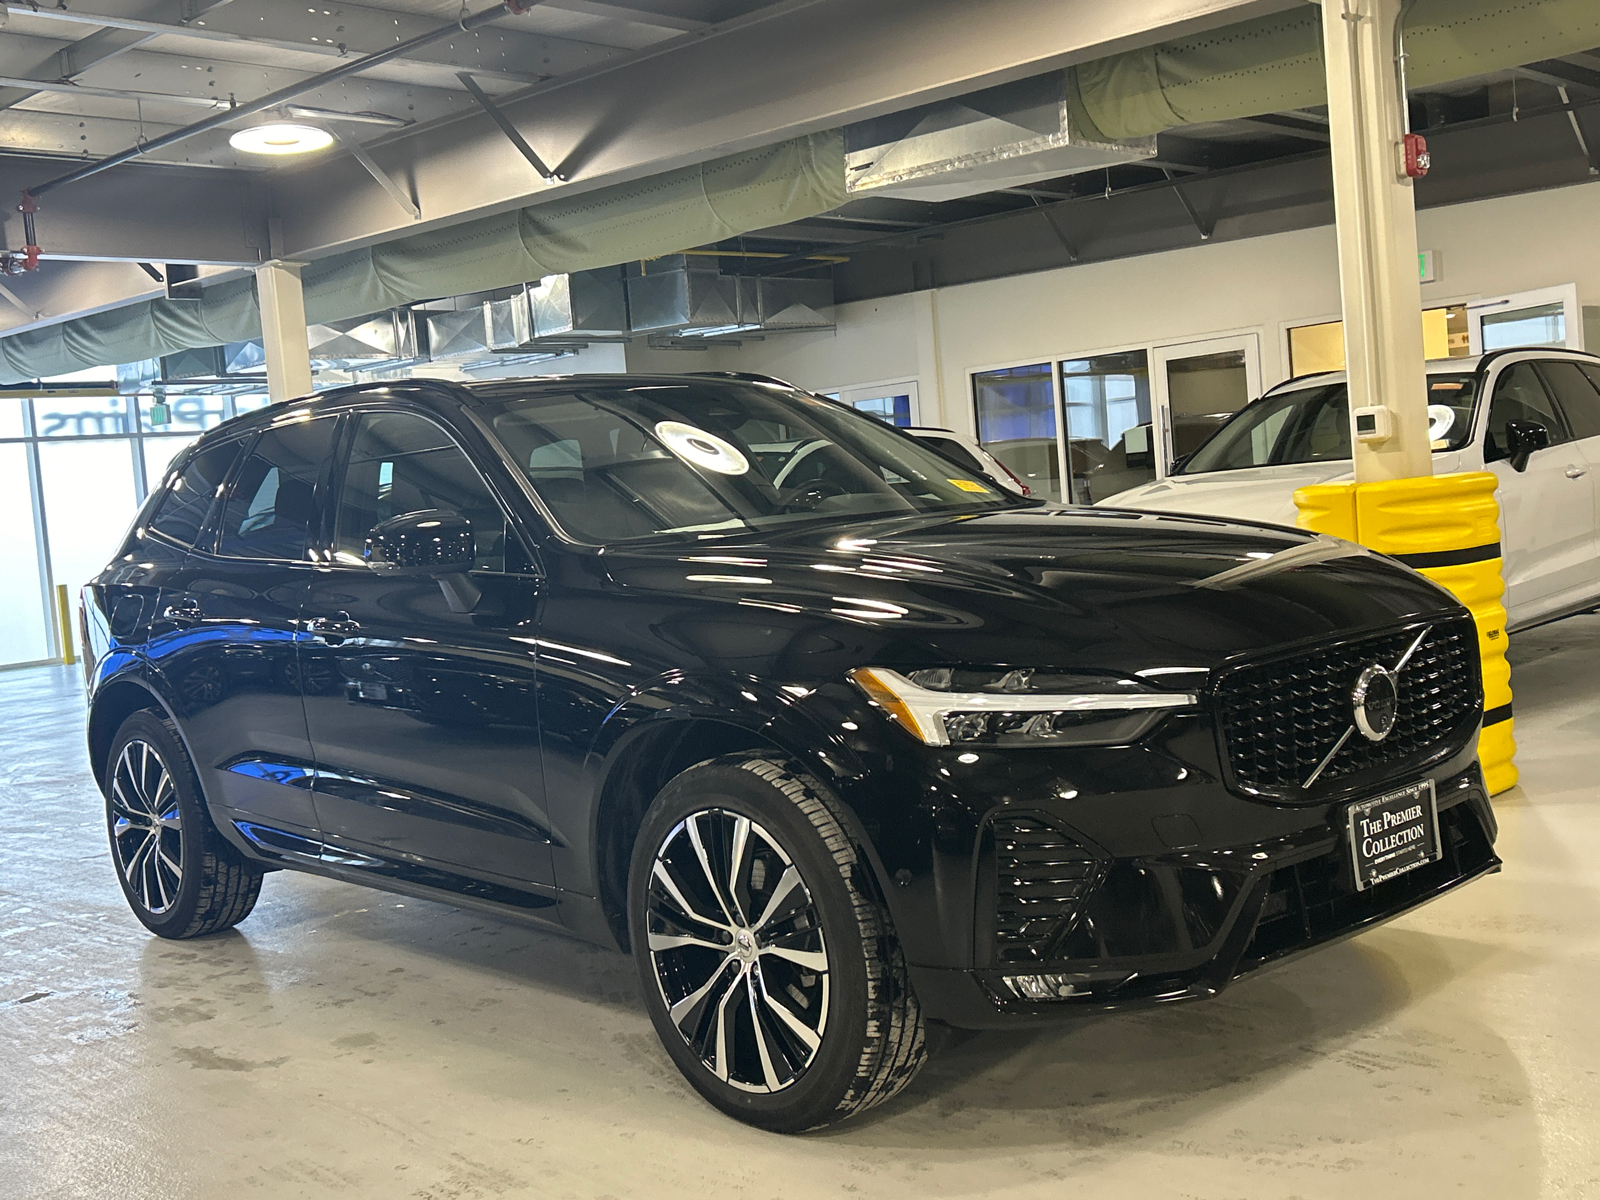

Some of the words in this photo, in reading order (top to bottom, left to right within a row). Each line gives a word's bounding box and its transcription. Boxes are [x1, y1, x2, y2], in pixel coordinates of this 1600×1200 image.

[1360, 818, 1383, 838] THE
[1382, 805, 1423, 830] PREMIER
[1362, 823, 1425, 858] COLLECTION
